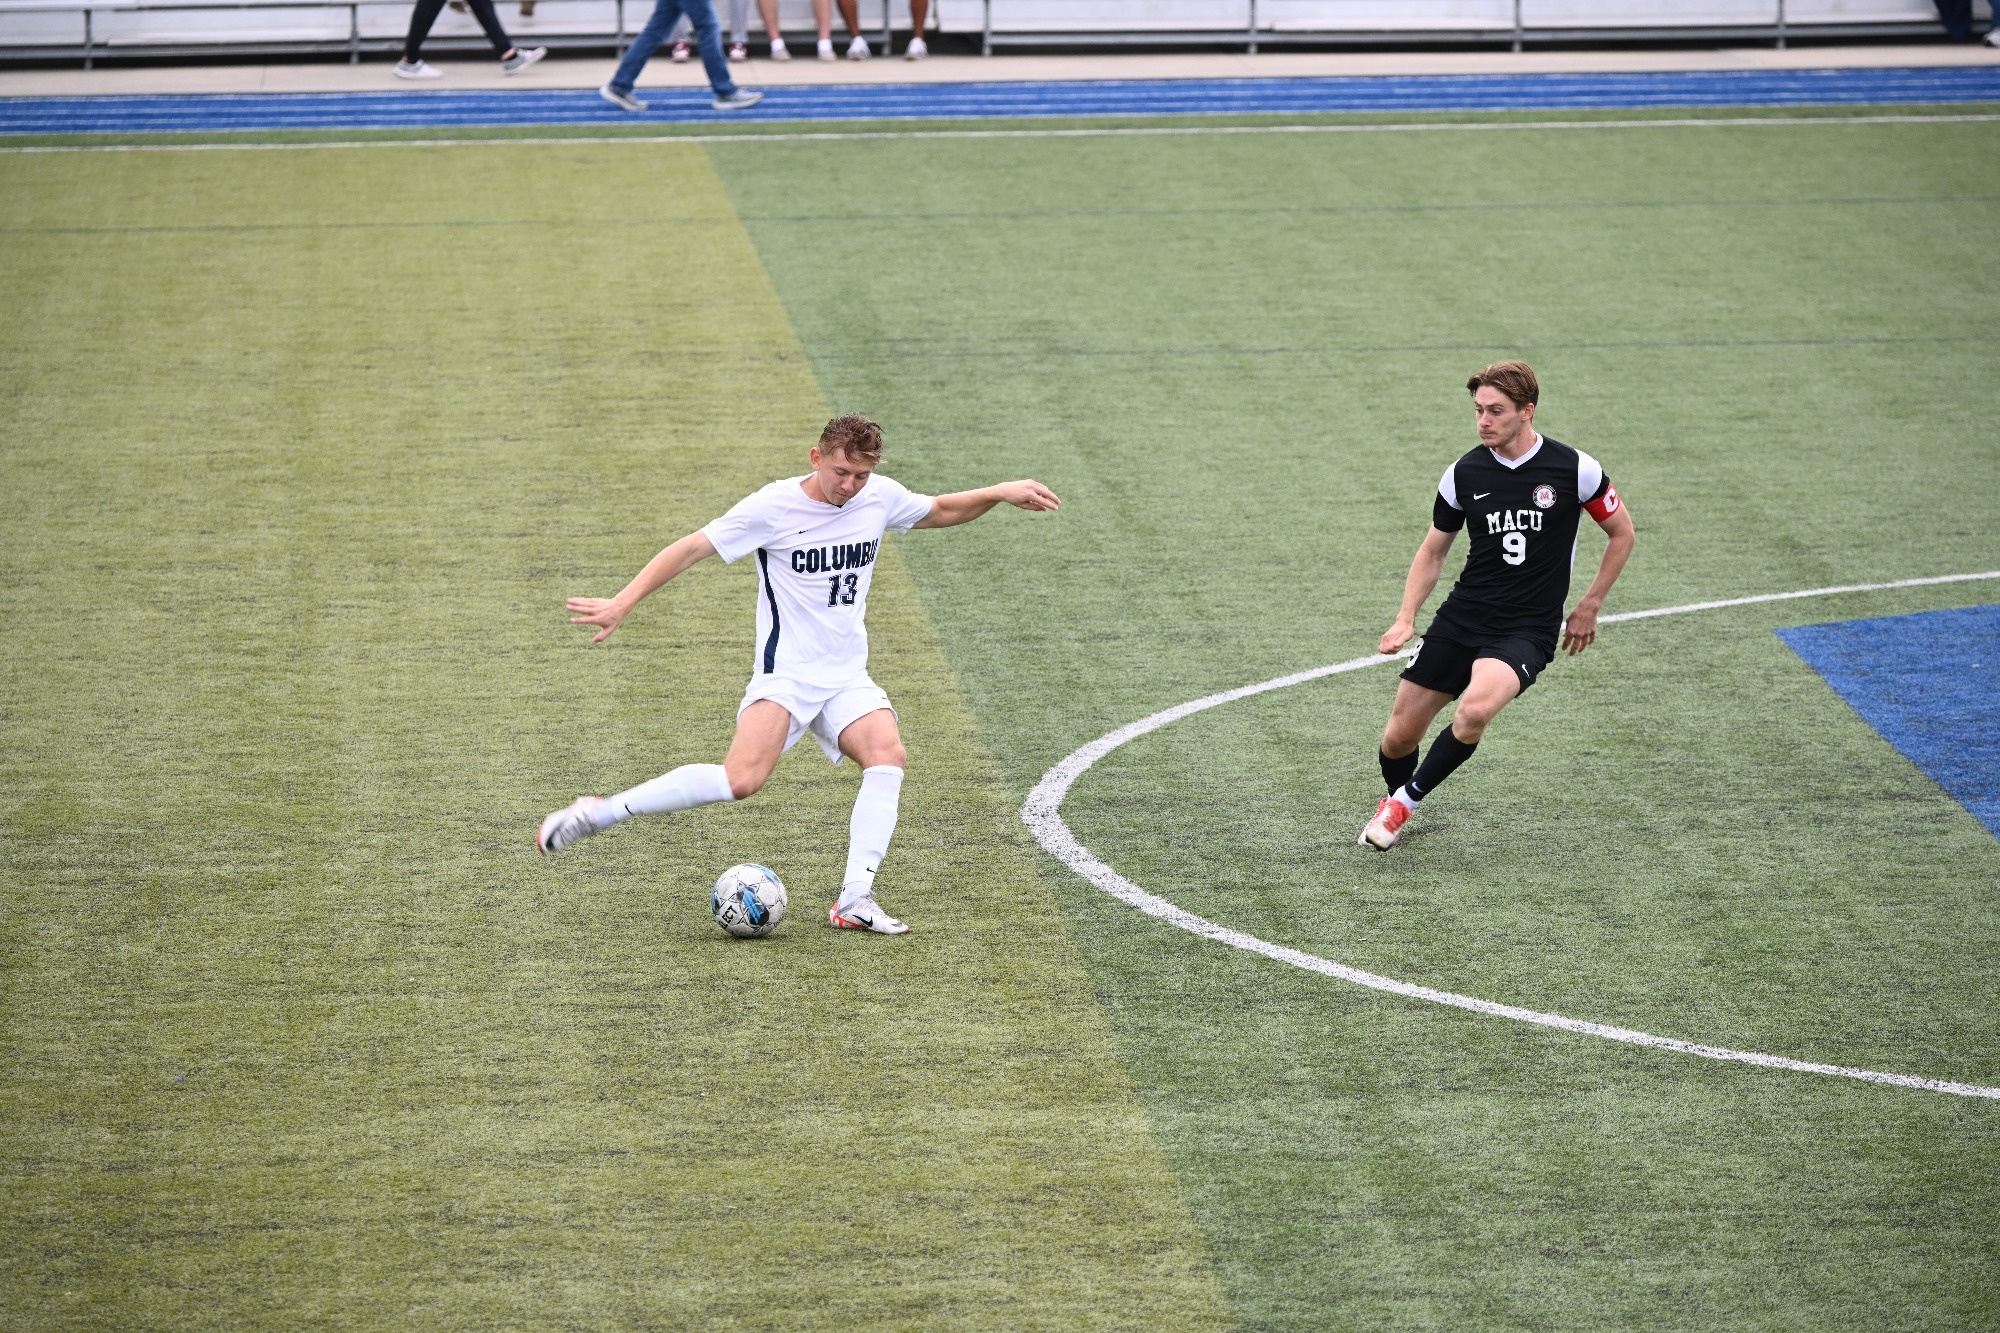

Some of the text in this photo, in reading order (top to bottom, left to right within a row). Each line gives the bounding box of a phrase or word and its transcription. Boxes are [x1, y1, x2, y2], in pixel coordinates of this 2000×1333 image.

[1602, 487, 1619, 513] C
[1485, 509, 1544, 535] MACU
[1502, 531, 1527, 566] 9
[827, 572, 859, 607] 13
[718, 905, 738, 929] LECT
